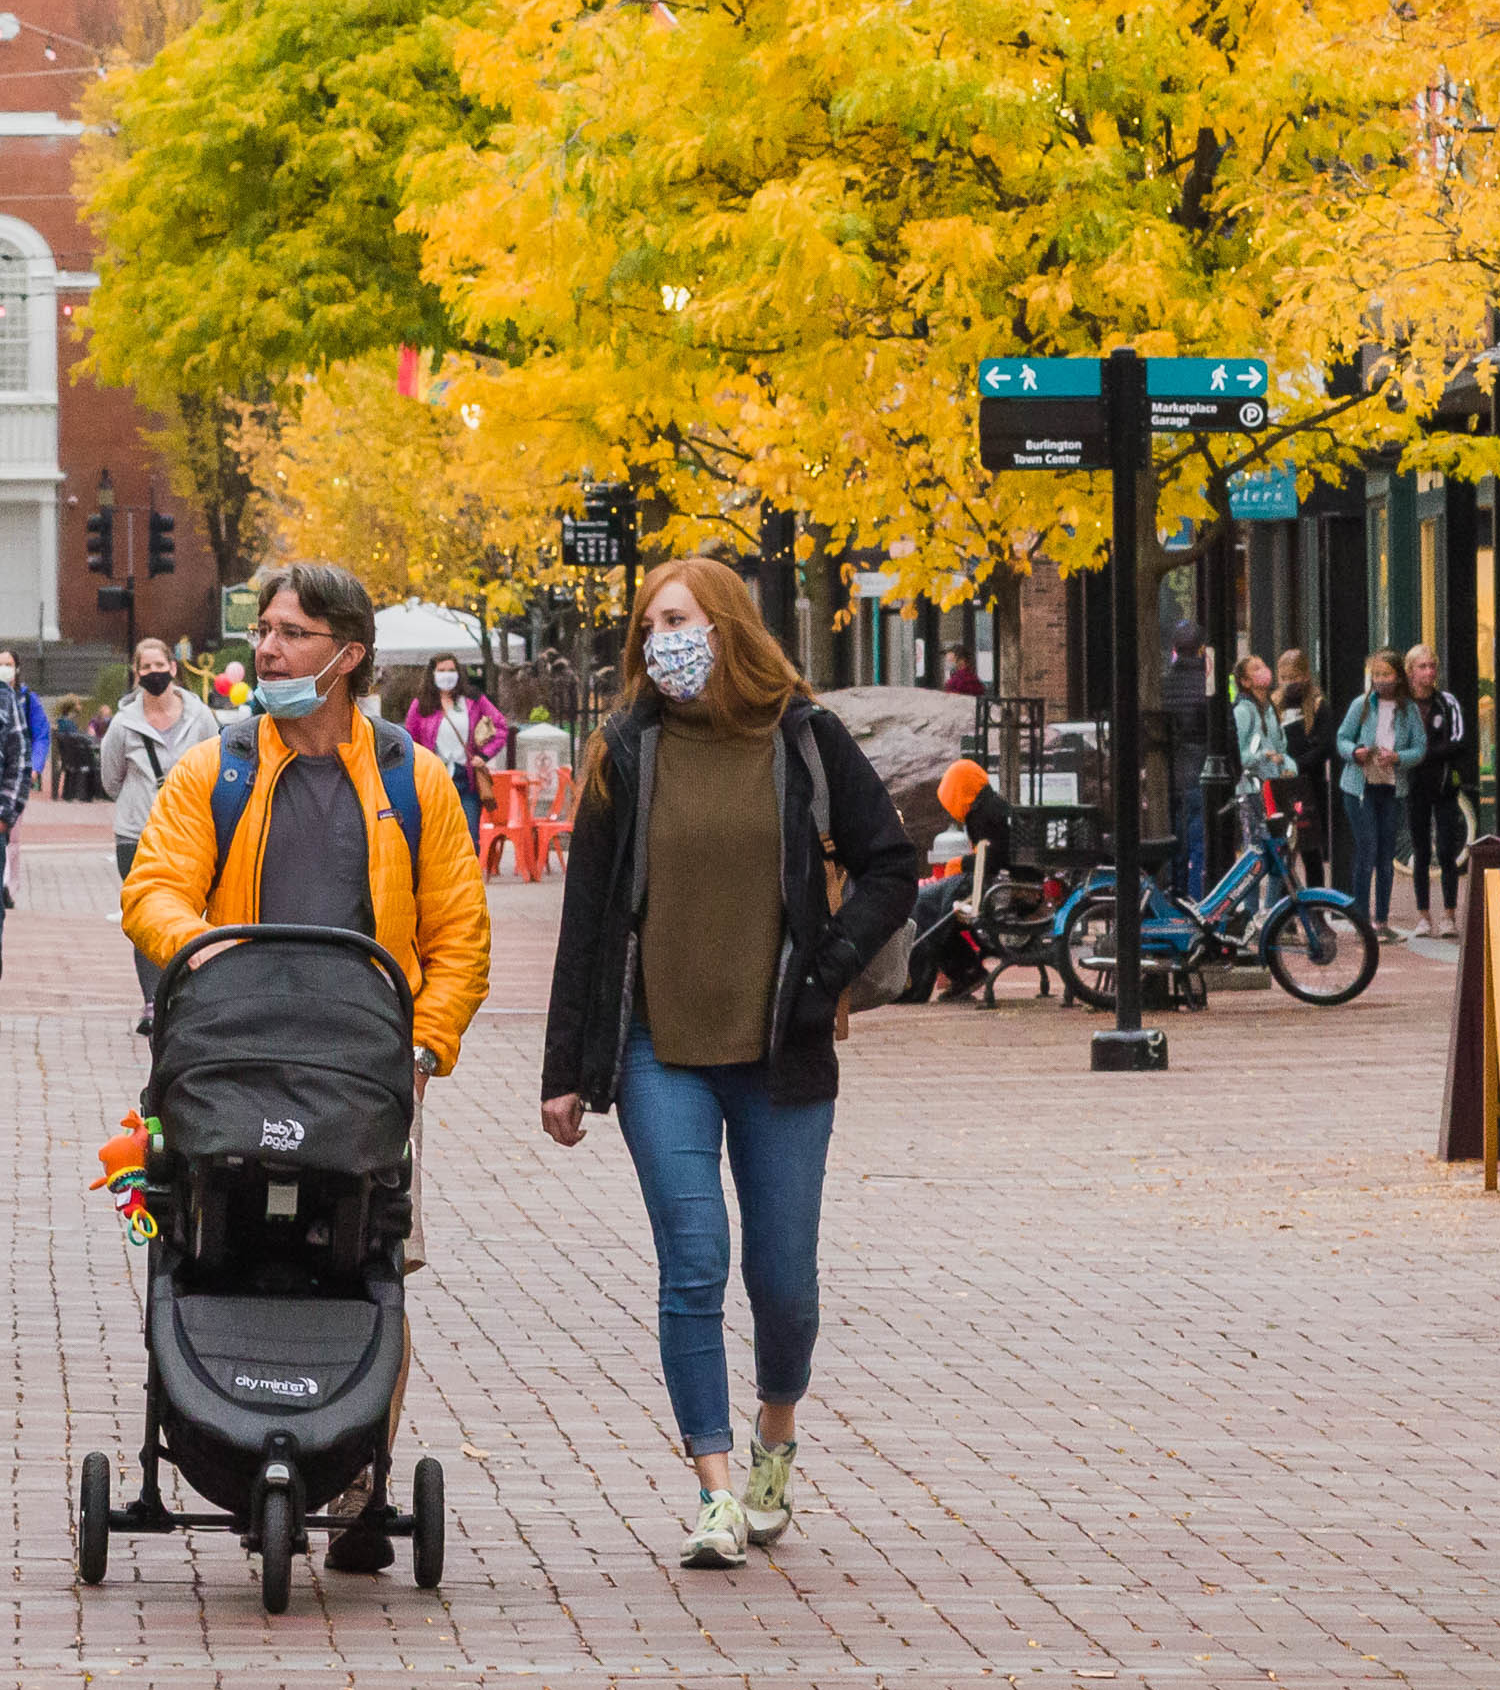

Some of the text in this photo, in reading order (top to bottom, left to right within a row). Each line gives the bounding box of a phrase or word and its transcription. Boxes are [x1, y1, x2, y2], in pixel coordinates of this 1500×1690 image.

[1151, 402, 1219, 416] Marketplace
[1151, 415, 1191, 428] Garage
[1025, 439, 1083, 452] Burlington
[1013, 453, 1082, 465] Town Center
[263, 1118, 292, 1139] baby
[260, 1131, 301, 1151] jogger
[235, 1374, 259, 1390] city
[260, 1378, 288, 1391] mini
